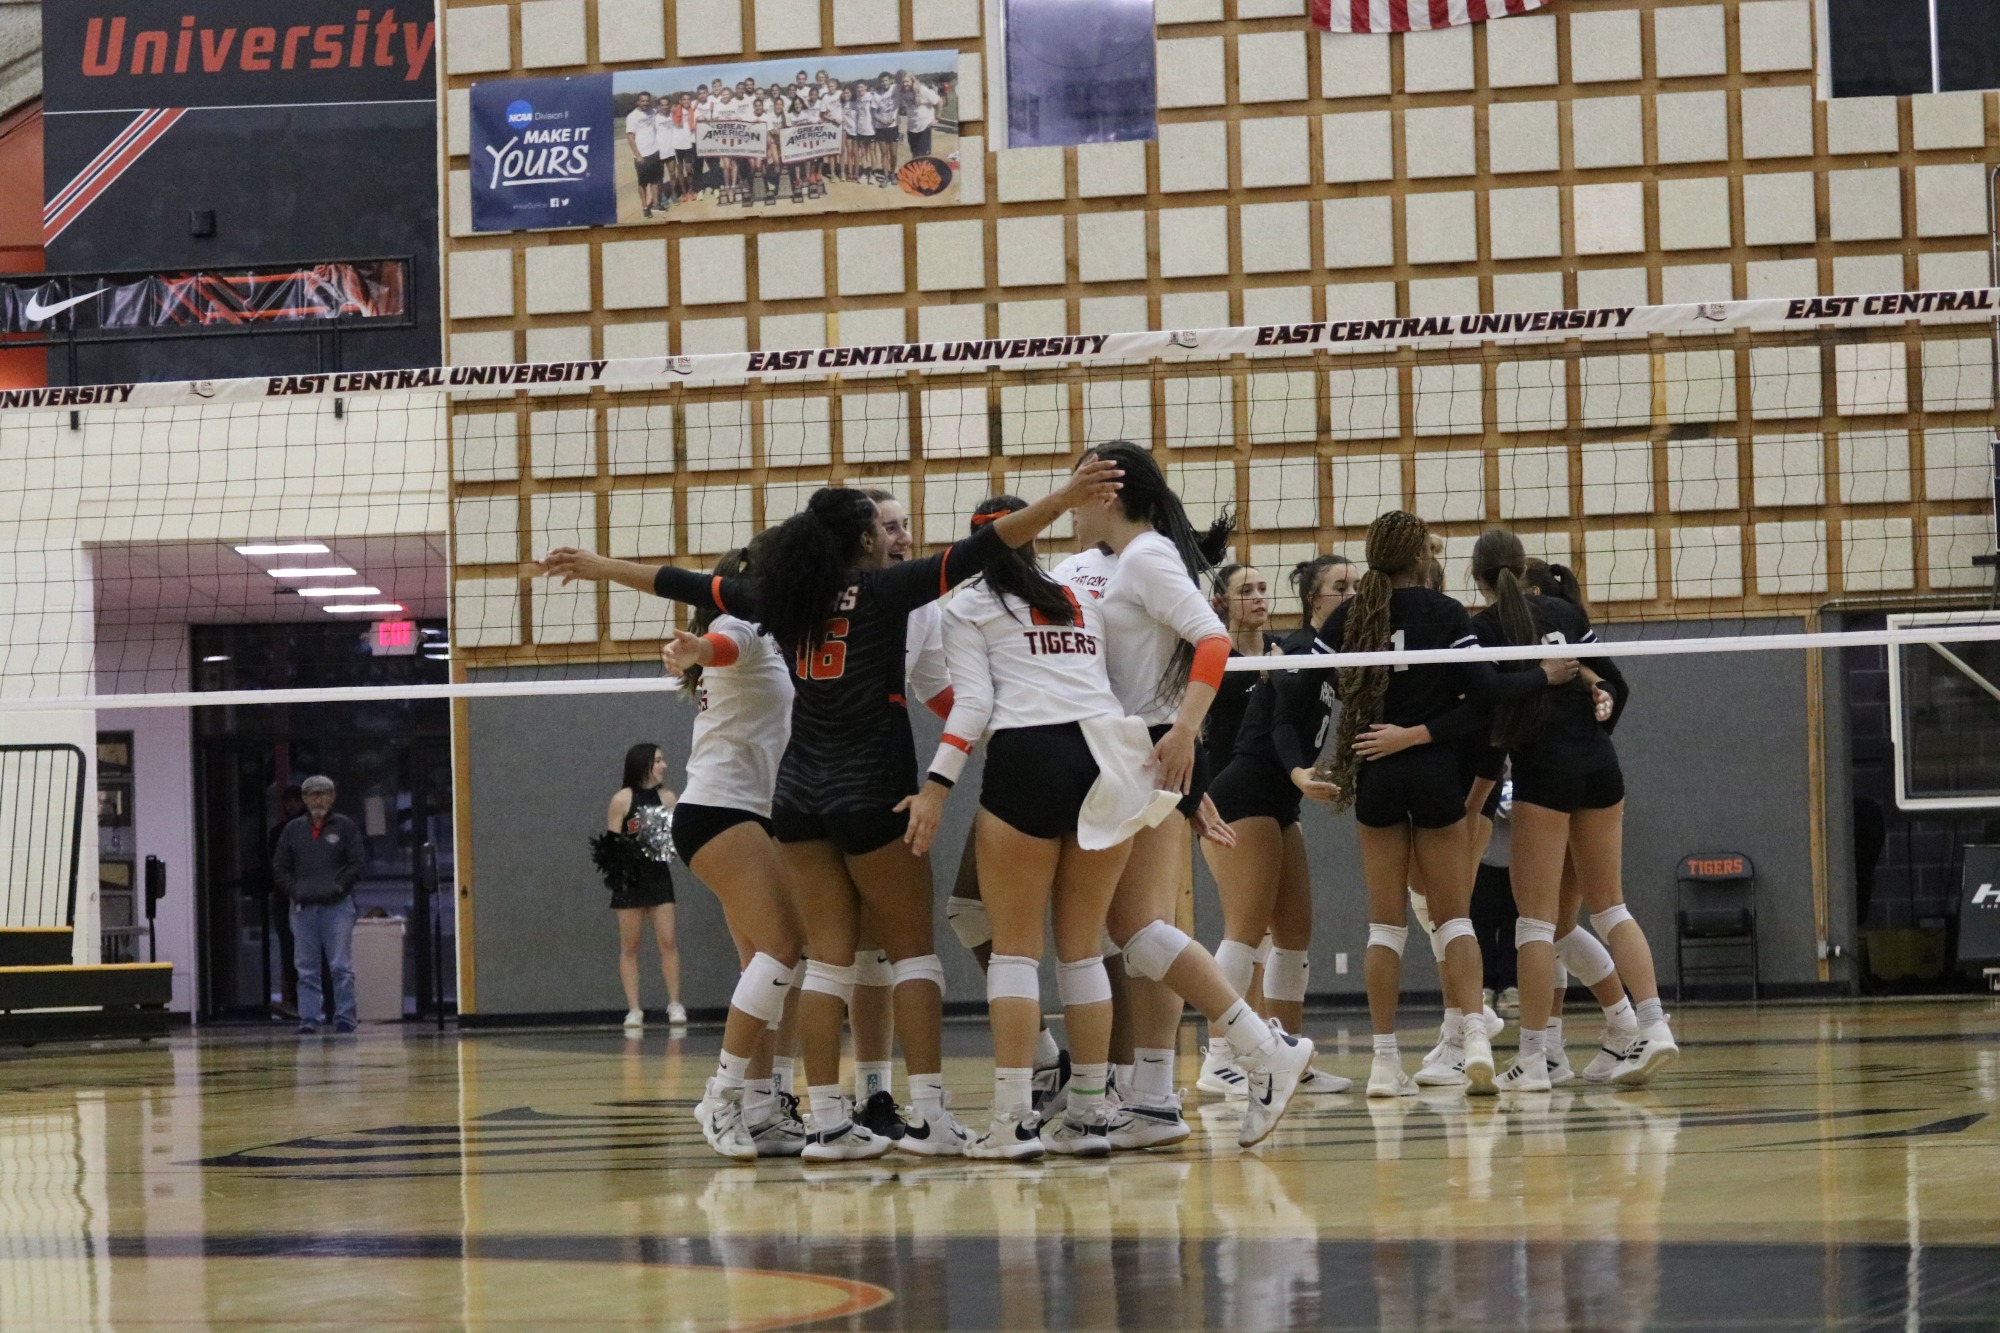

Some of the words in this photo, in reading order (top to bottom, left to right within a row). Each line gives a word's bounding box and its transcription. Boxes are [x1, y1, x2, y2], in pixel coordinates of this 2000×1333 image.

[82, 9, 435, 81] University
[523, 128, 571, 144] MAKE
[574, 127, 591, 141] IT
[702, 130, 760, 141] AMERICAN
[716, 123, 747, 132] GREAT
[785, 131, 837, 146] AMERICAN
[797, 126, 825, 135] GREAT
[1785, 297, 1859, 319] EAST
[1863, 290, 1993, 316] CENTRAL
[1255, 323, 1326, 346] EAST
[1329, 316, 1454, 342] CENTRAL
[1460, 307, 1635, 334] UNIVERSITY
[746, 350, 815, 372] EAST
[817, 343, 937, 367] CENTRAL
[942, 334, 1110, 362] UNIVERSITY
[266, 374, 330, 396] EAST
[332, 369, 445, 393] CENTRAL
[449, 361, 608, 386] UNIVERSITY
[0, 384, 136, 409] NIVERSITY
[1023, 631, 1097, 656] TIGERS
[1687, 858, 1744, 875] TIGERS
